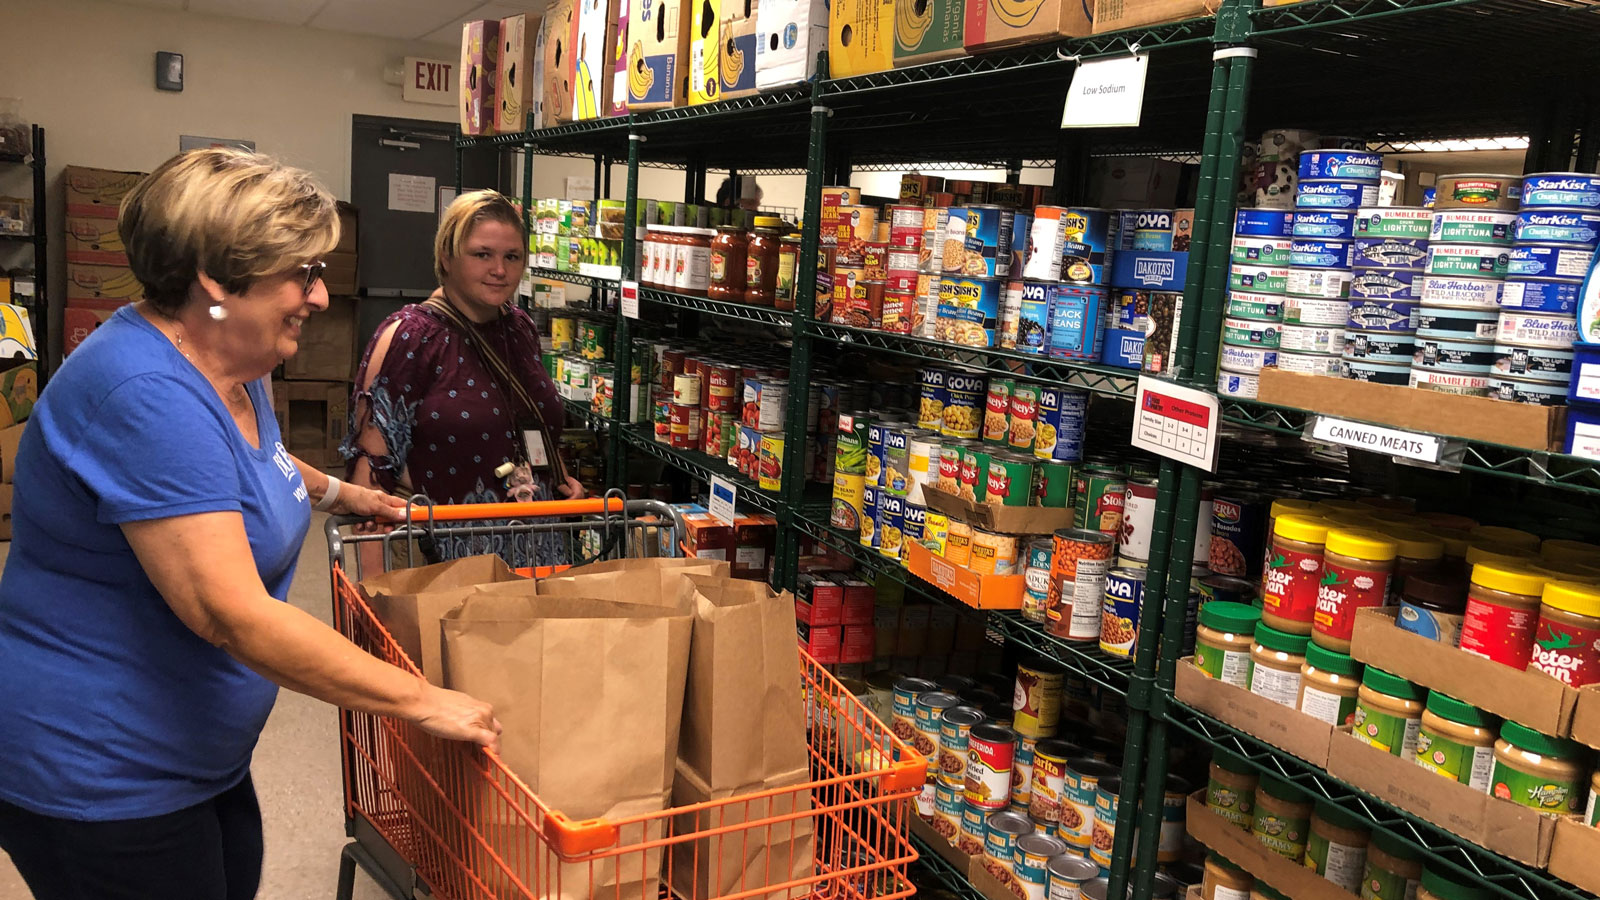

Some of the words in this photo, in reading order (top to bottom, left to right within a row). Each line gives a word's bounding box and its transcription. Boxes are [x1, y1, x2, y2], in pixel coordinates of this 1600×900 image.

[641, 0, 651, 22] es
[942, 0, 953, 43] ananas
[951, 0, 962, 41] rganic
[415, 61, 452, 92] EXIT
[664, 56, 674, 100] Bananas
[1083, 85, 1097, 95] Low
[1098, 84, 1126, 94] Sodium
[1345, 155, 1381, 165] StarKist
[1302, 185, 1338, 194] StarKist
[1536, 180, 1586, 190] StarKist
[1536, 193, 1558, 201] Chunk
[1559, 193, 1578, 202] Light
[1066, 217, 1085, 230] USH'S
[1136, 214, 1170, 228] OYA
[1296, 214, 1329, 223] StarKist
[1529, 215, 1577, 225] StarKist
[1444, 228, 1466, 236] LIGHT
[1551, 228, 1569, 237] Light
[1291, 244, 1323, 253] StarKist
[1387, 255, 1410, 263] TUNA
[1510, 250, 1528, 259] rKist
[1138, 259, 1172, 276] DAKOTA'S
[1434, 260, 1455, 268] LIGHT
[1456, 261, 1478, 269] TUNA
[940, 284, 960, 295] USH'S
[1369, 287, 1389, 295] TUNA
[1428, 281, 1446, 289] Blue
[1447, 282, 1485, 291] Harbor
[959, 285, 979, 298] USH'S
[1022, 287, 1045, 300] OYA
[1447, 290, 1485, 298] ALBACORE
[1233, 294, 1254, 302] BUMBLE
[1054, 309, 1081, 319] BLACK
[1053, 319, 1081, 329] BEANS
[1367, 318, 1388, 326] TUNA
[1522, 319, 1548, 329] Blue
[1551, 321, 1578, 331] Harb
[1233, 333, 1249, 341] TUNA
[1528, 328, 1549, 336] WILD
[1551, 330, 1578, 338] ALBAC
[1124, 341, 1144, 353] DAKO
[1441, 349, 1456, 357] Chunk
[1532, 356, 1548, 364] Chunk
[1549, 358, 1566, 366] Light
[710, 376, 728, 386] unt's
[948, 377, 984, 391] GOYA
[1429, 374, 1467, 387] BUMBLE
[1470, 376, 1487, 388] BEE
[1432, 385, 1457, 394] Chunk
[1041, 393, 1056, 406] YA
[1518, 391, 1534, 399] Chunk
[1535, 393, 1550, 401] Light
[1012, 400, 1035, 415] kely's
[1171, 405, 1184, 414] Other
[1185, 409, 1203, 419] Proteins
[1143, 415, 1154, 423] Family
[868, 428, 880, 440] YA
[1144, 431, 1157, 439] Choices
[889, 436, 905, 448] YA
[1329, 426, 1378, 445] CANNED
[1379, 434, 1424, 454] MEATS
[884, 500, 901, 512] YA
[1033, 558, 1050, 569] EDEN
[1264, 561, 1293, 586] Peter
[1028, 575, 1049, 585] ADUK
[1318, 585, 1347, 605] eter
[1532, 643, 1583, 672] Peter
[1034, 756, 1059, 776] sarita
[1528, 785, 1569, 799] Hampton
[917, 793, 935, 802] Refri
